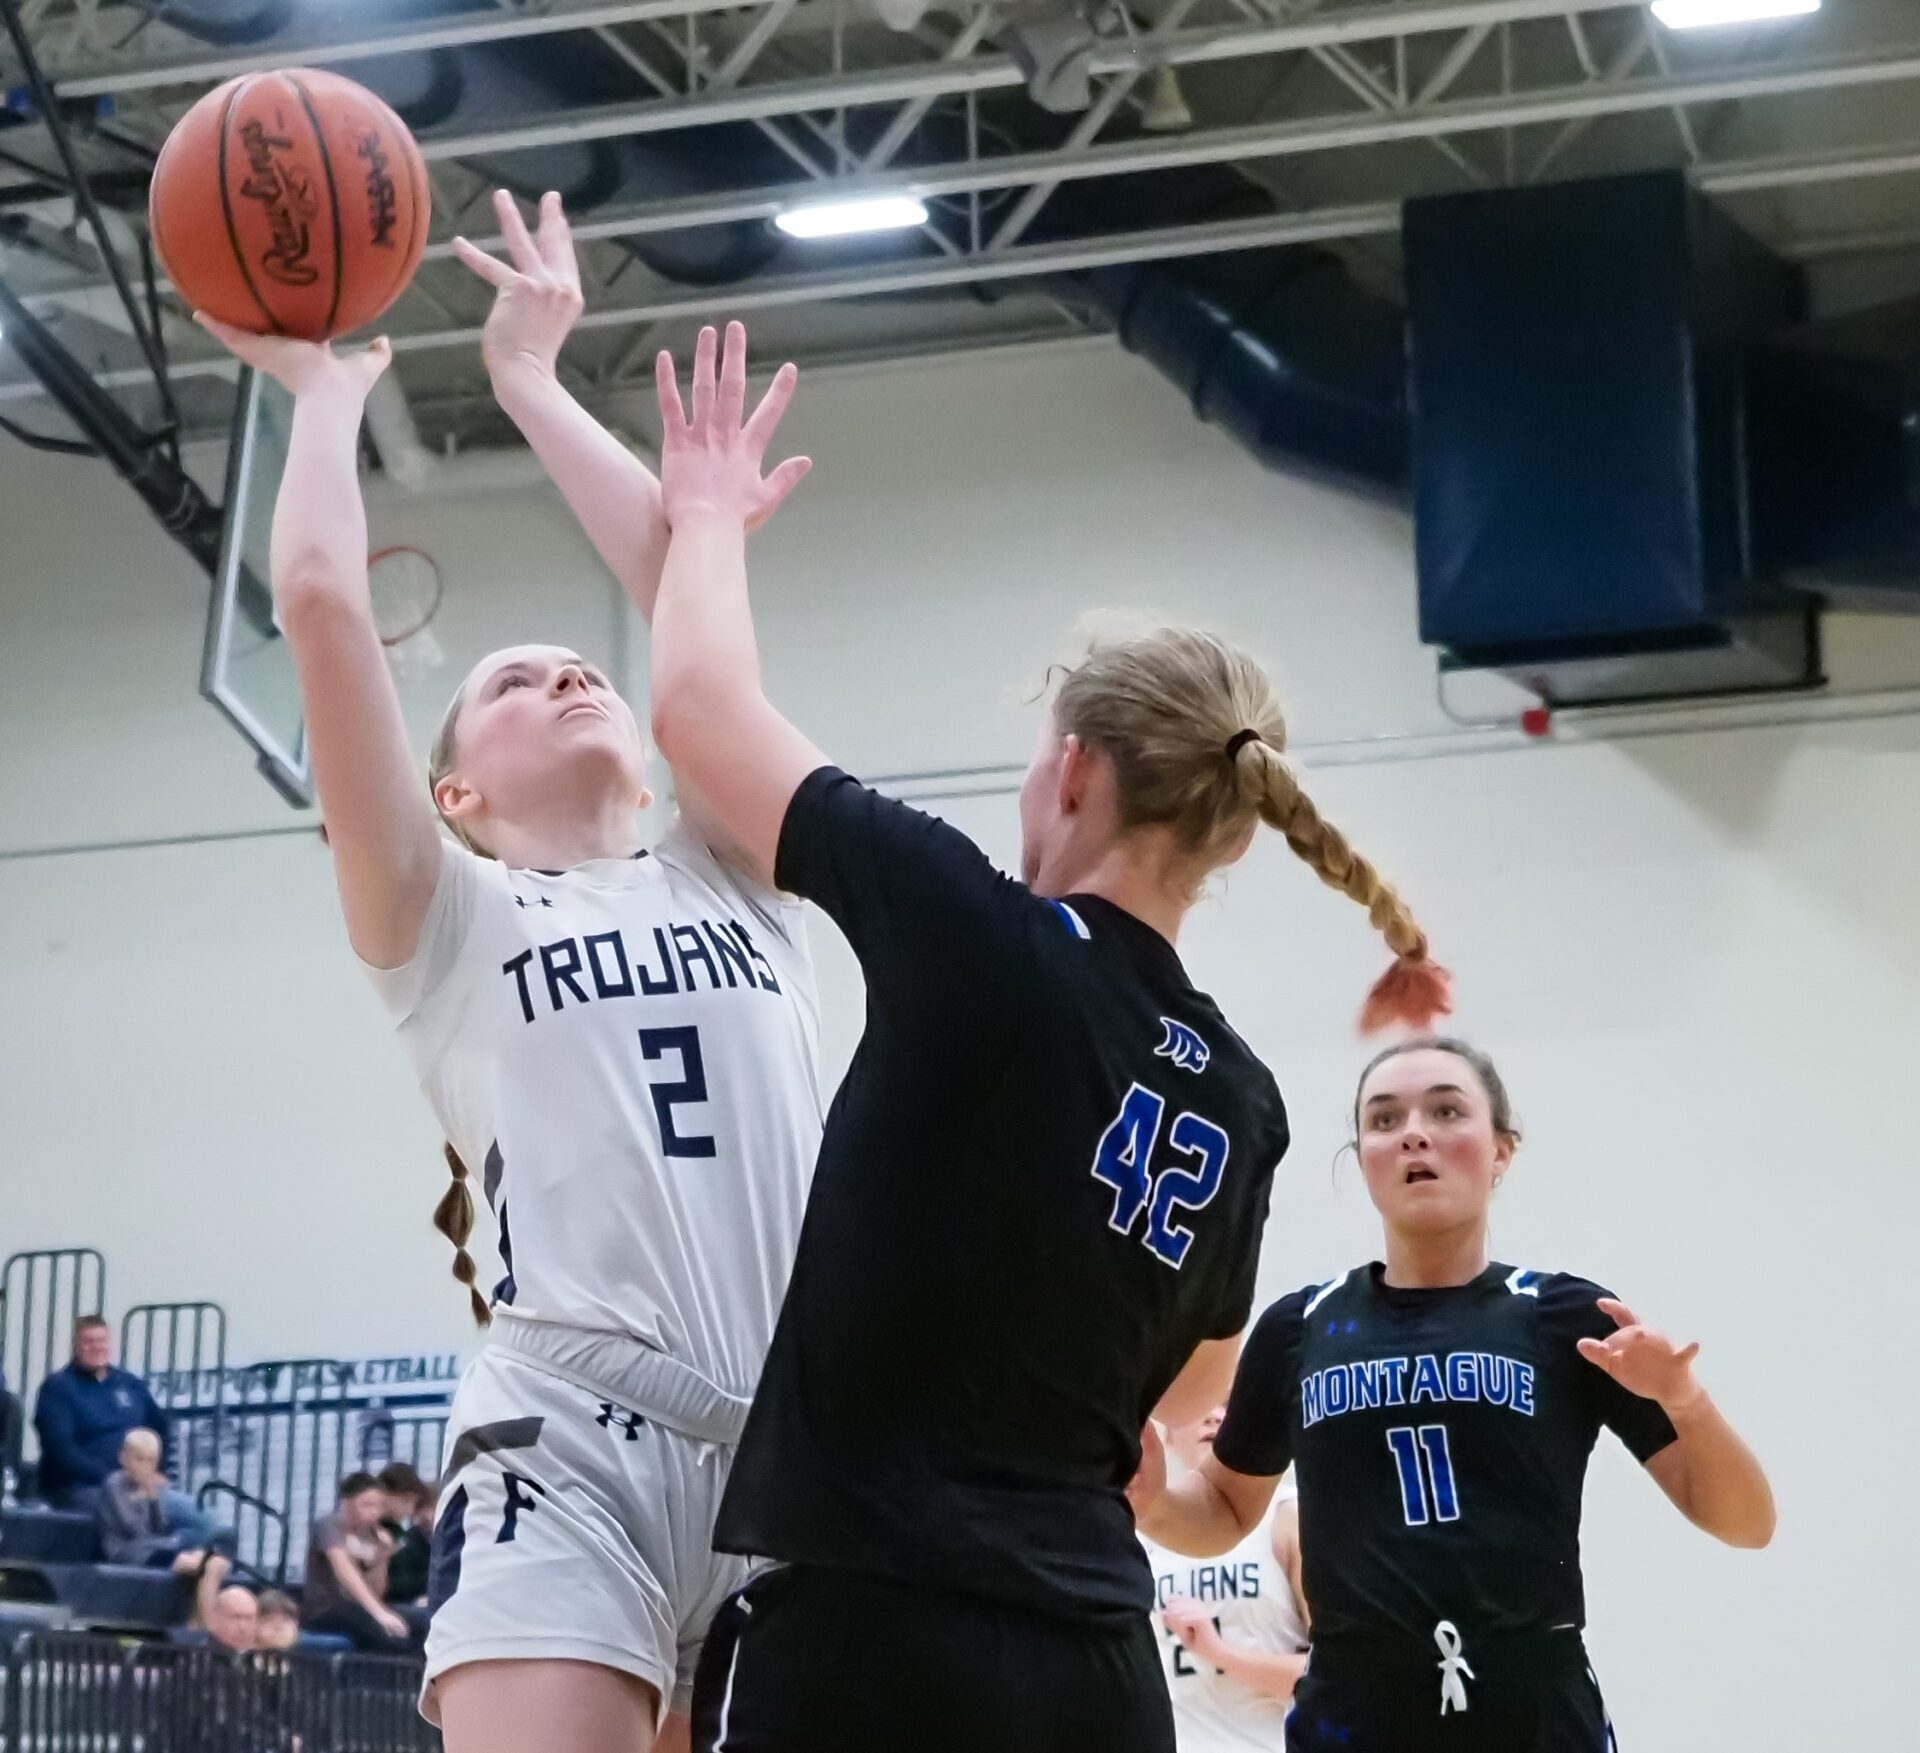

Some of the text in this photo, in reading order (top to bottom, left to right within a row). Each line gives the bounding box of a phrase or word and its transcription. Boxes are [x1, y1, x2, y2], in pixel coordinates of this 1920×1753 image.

[502, 918, 783, 1024] TROJANS
[637, 1025, 717, 1157] 2
[1090, 1081, 1230, 1270] 42
[1301, 1352, 1535, 1429] MONTAGUE
[495, 1471, 546, 1544] F
[1386, 1425, 1460, 1526] 11
